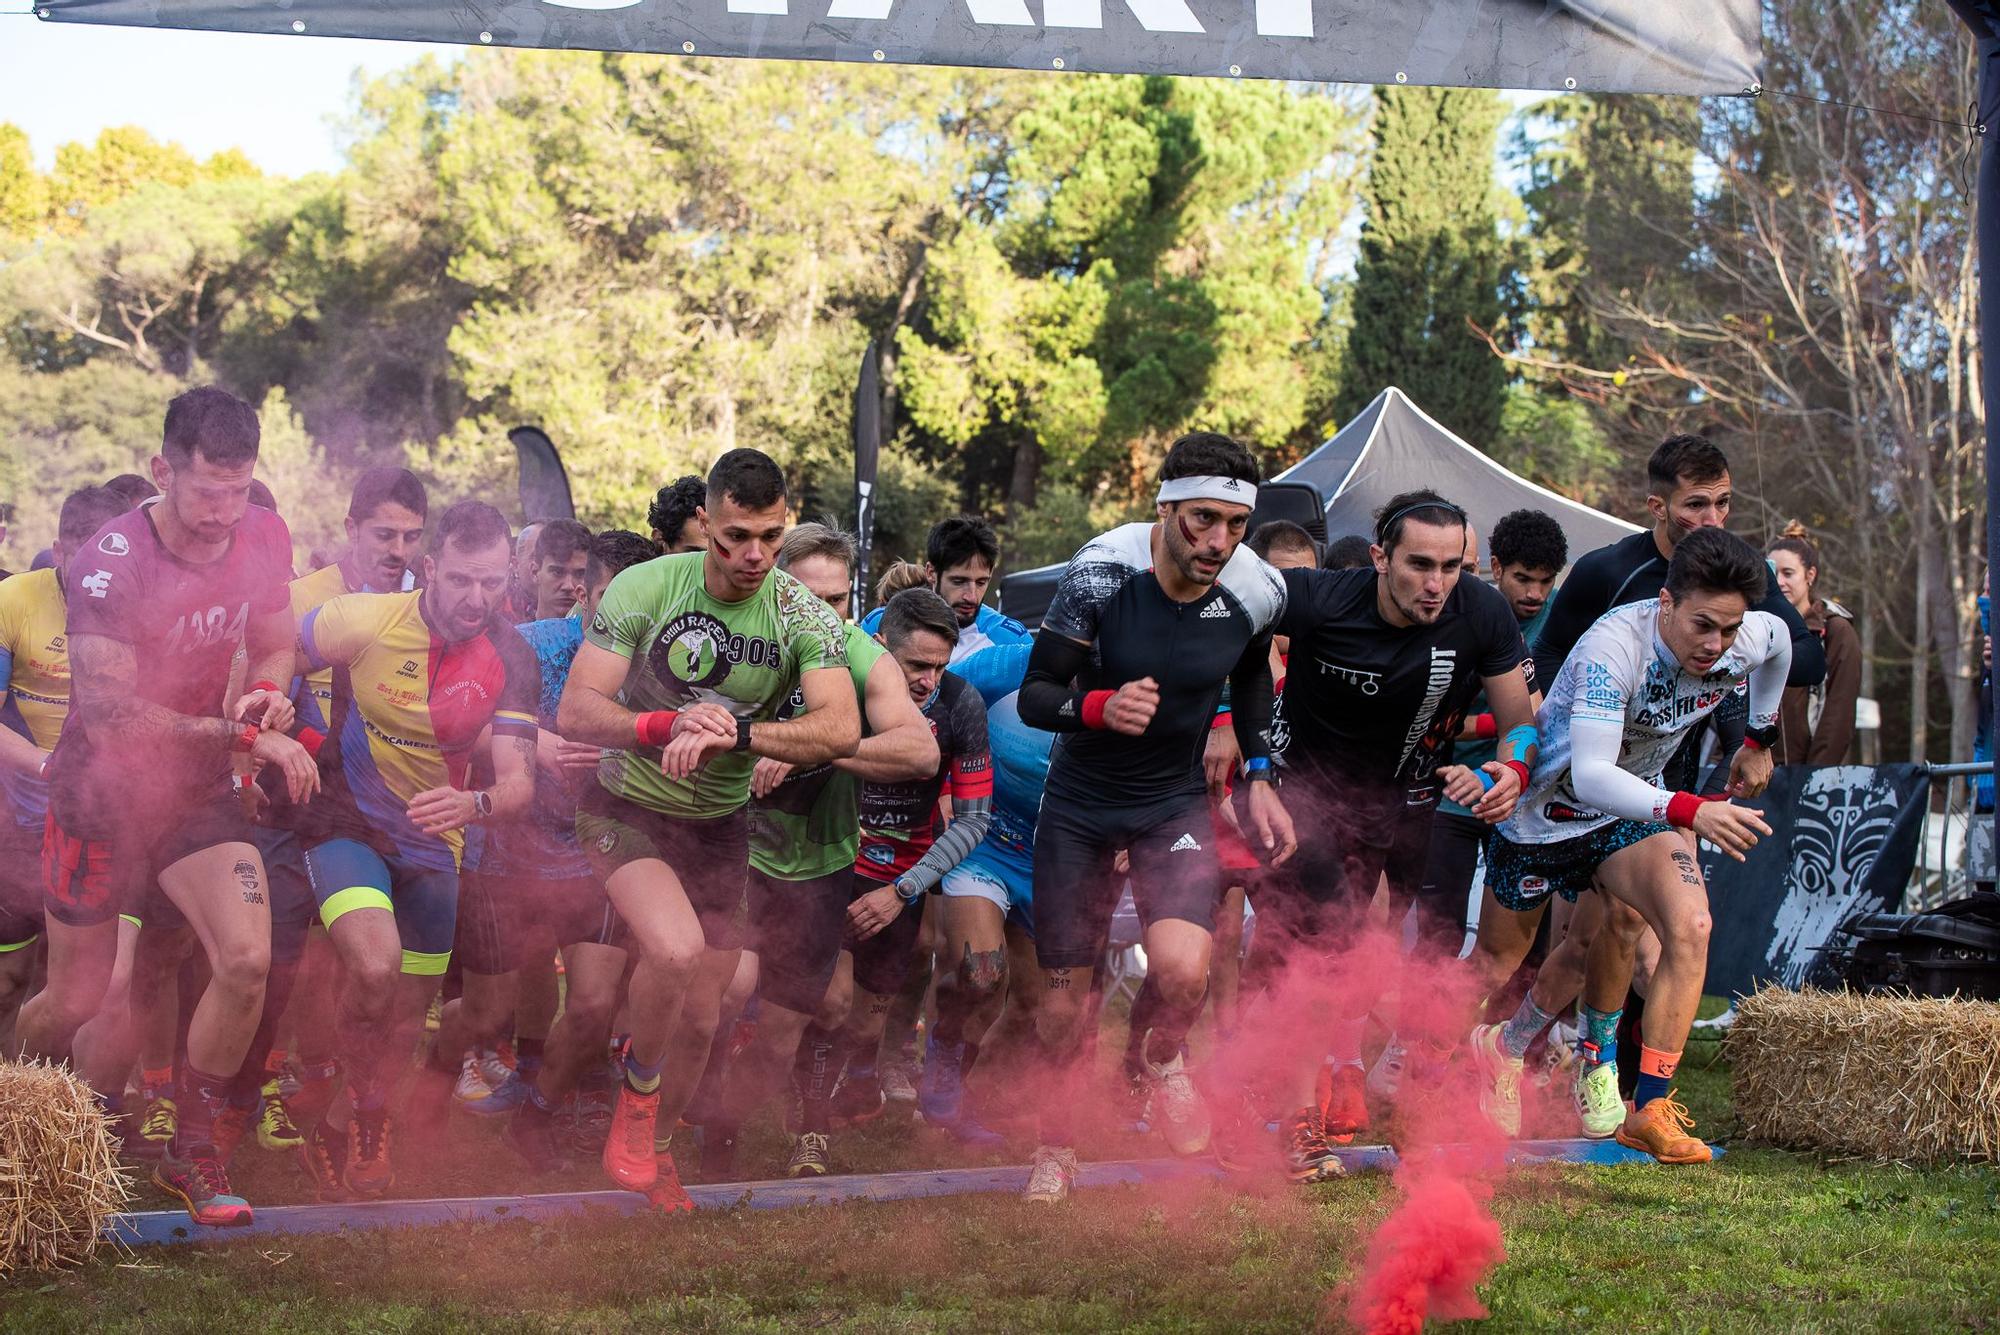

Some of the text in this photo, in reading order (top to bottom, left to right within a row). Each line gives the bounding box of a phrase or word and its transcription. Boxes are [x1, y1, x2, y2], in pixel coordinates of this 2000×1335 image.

[1200, 610, 1231, 618] adidas
[687, 615, 728, 653] RACERS
[726, 632, 783, 671] 905
[242, 891, 264, 905] 3066
